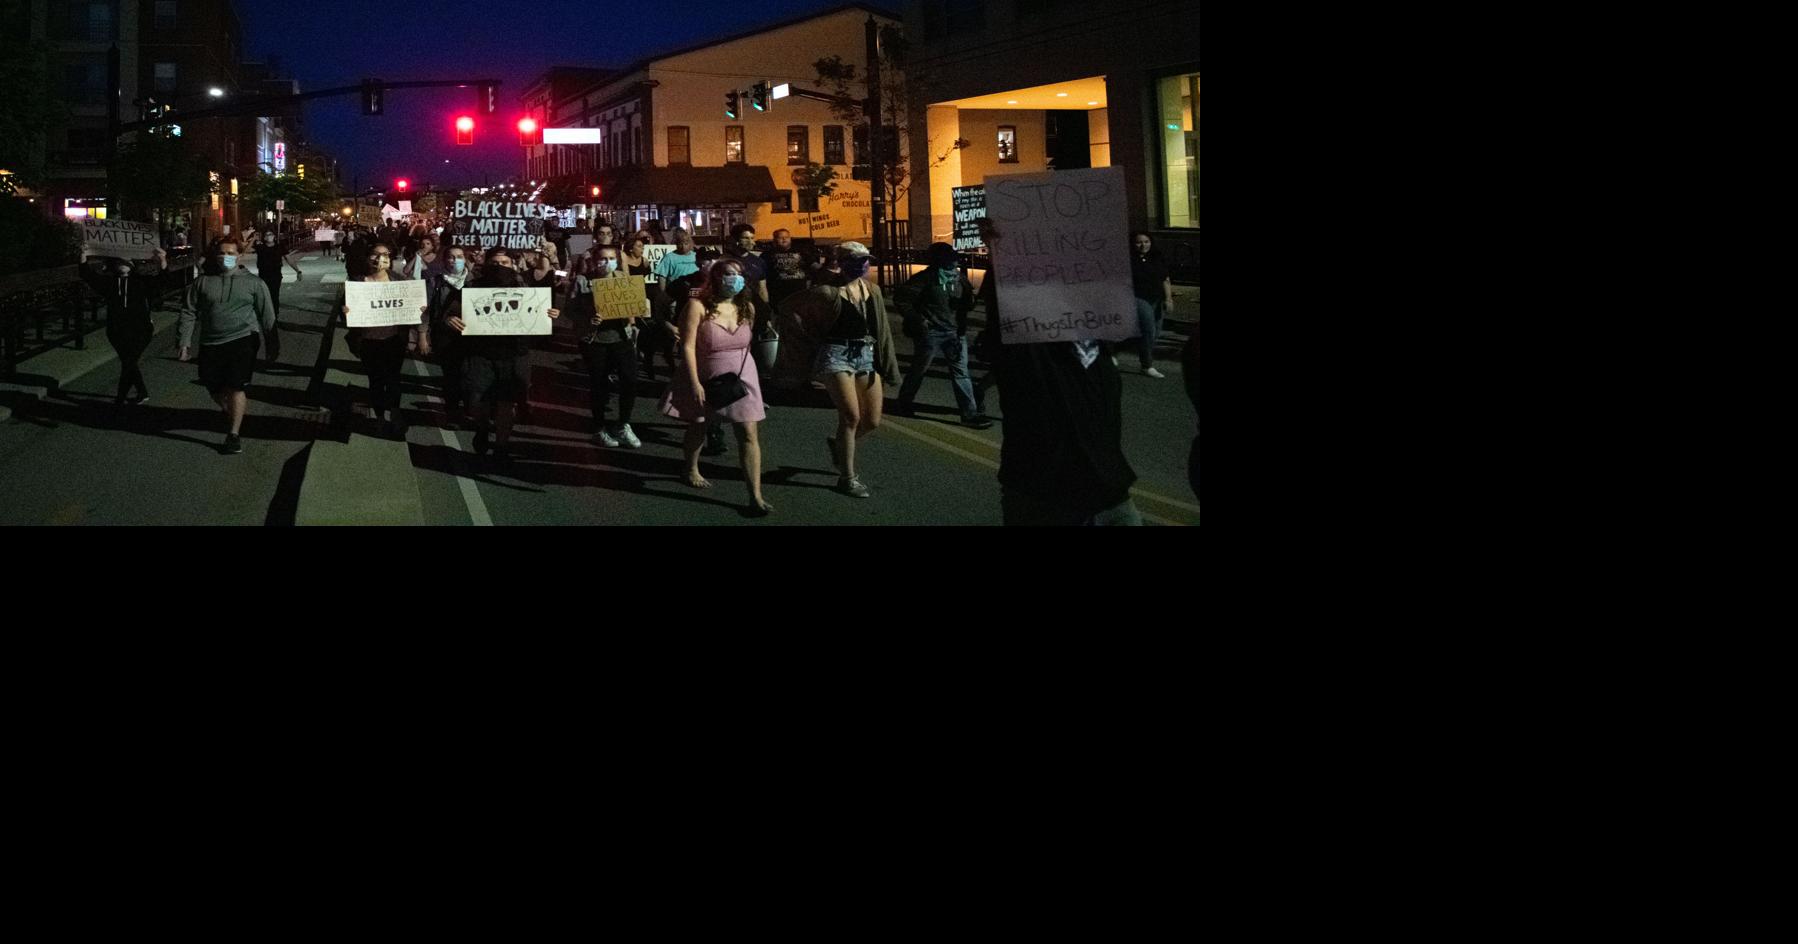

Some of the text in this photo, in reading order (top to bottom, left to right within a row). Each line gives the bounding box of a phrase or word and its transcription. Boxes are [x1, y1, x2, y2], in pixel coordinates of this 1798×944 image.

[996, 179, 1110, 222] STOP
[455, 200, 546, 219] BLACK LIVES
[954, 208, 987, 222] WEAPON
[469, 219, 528, 234] MATTER
[86, 230, 155, 245] MATTER
[479, 235, 498, 247] YOU
[603, 290, 637, 303] LIVES
[370, 299, 404, 309] LIVES
